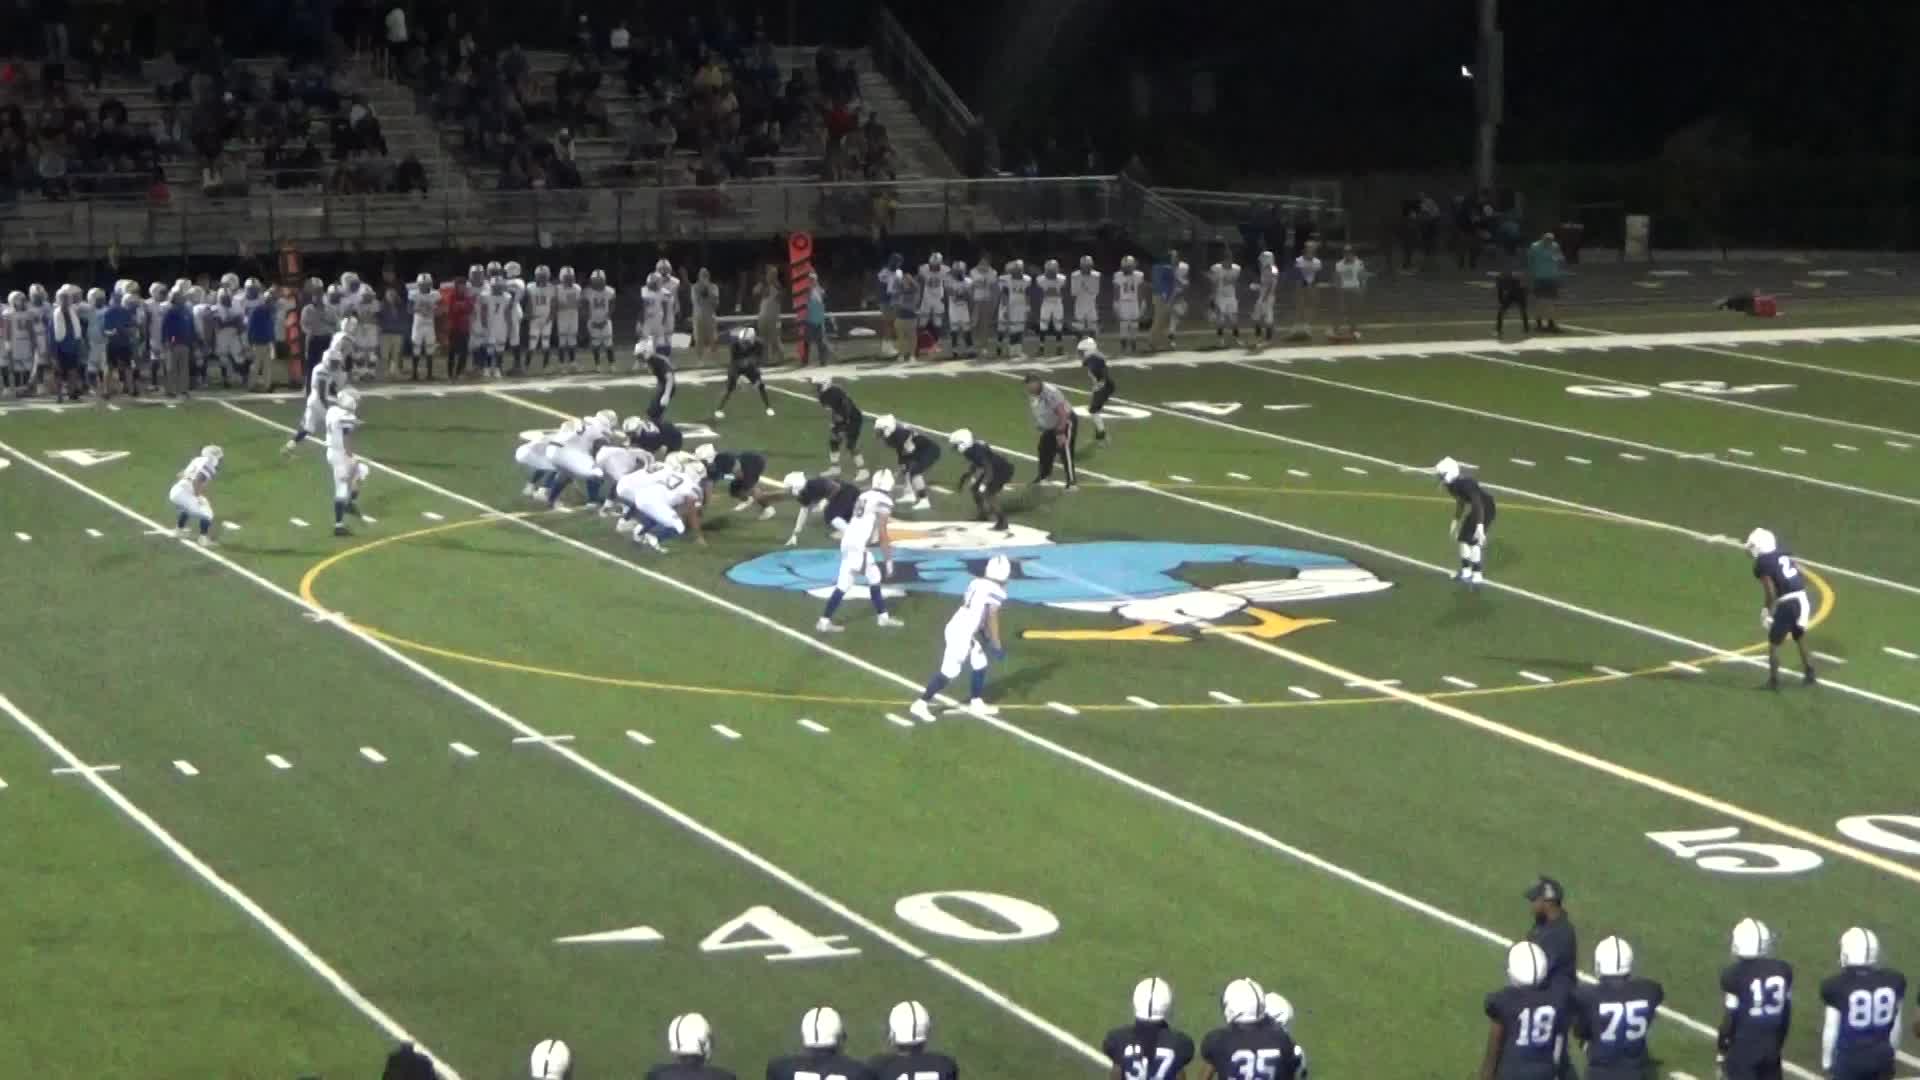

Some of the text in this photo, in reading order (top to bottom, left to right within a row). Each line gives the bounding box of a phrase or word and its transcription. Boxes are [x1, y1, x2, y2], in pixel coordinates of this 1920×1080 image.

[1777, 555, 1798, 578] 2
[1748, 975, 1786, 1018] 13
[1847, 986, 1897, 1028] 88
[1515, 1005, 1557, 1047] 18
[1598, 999, 1650, 1042] 75
